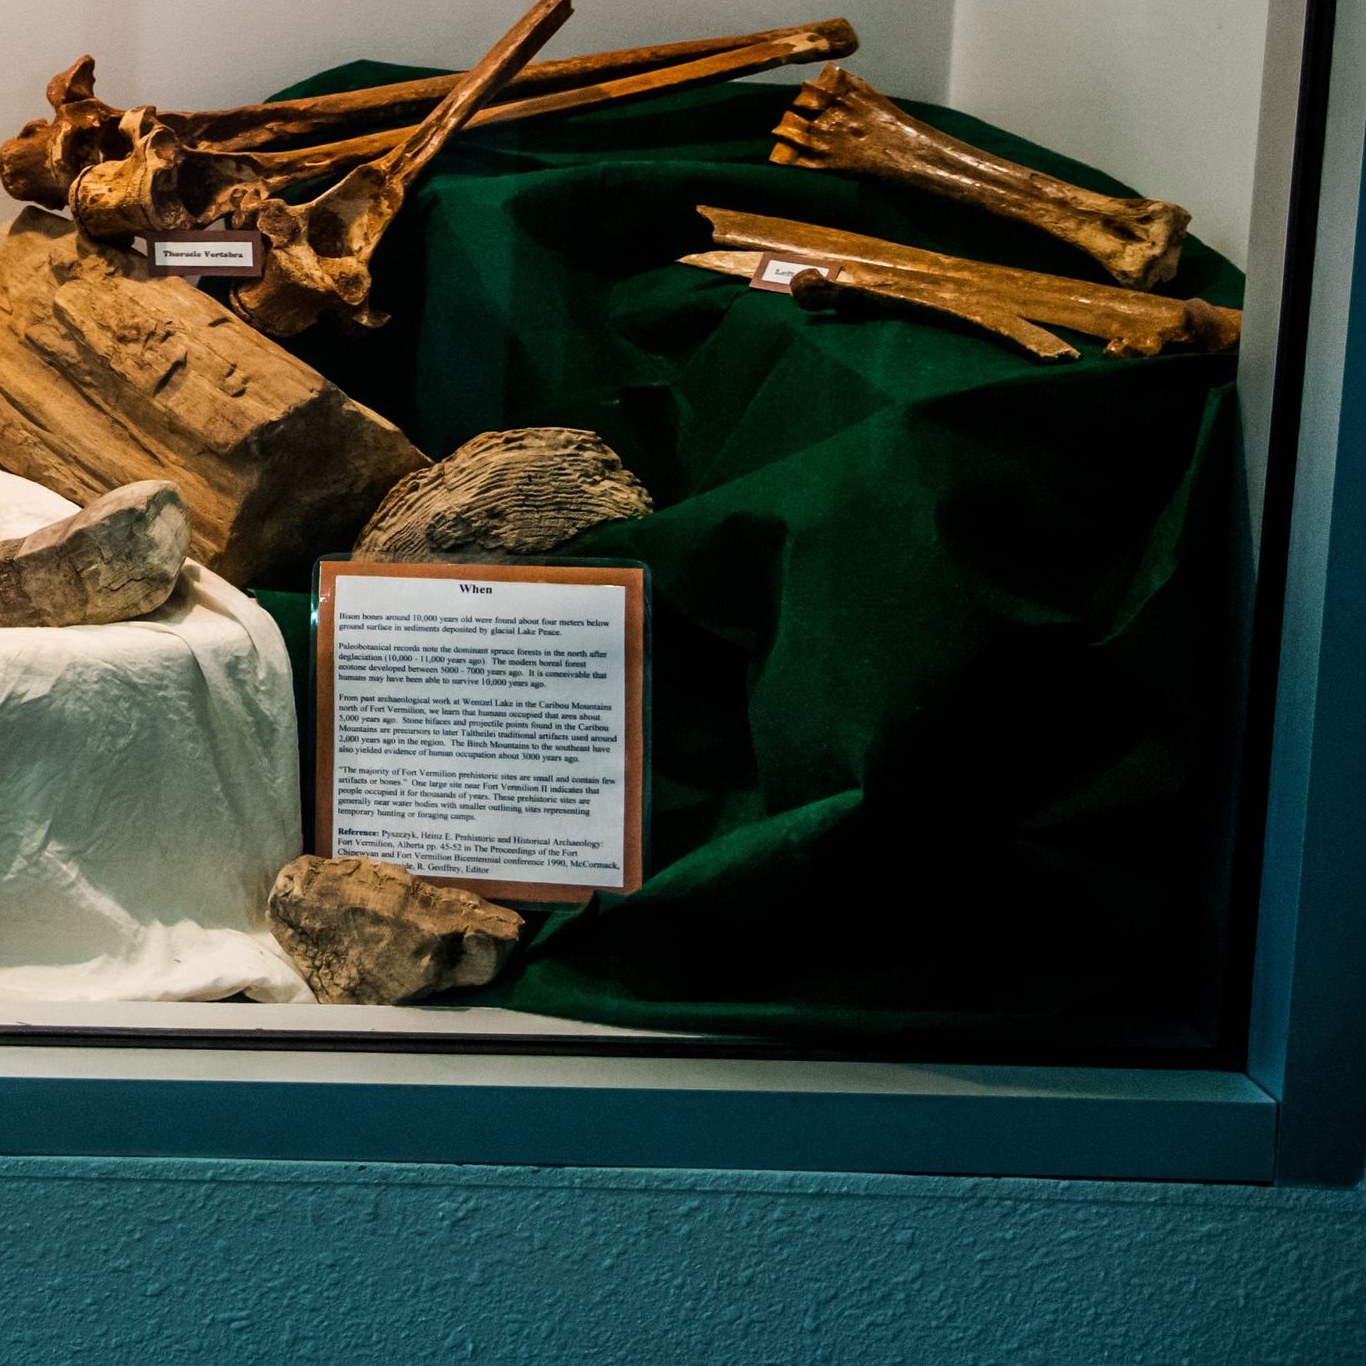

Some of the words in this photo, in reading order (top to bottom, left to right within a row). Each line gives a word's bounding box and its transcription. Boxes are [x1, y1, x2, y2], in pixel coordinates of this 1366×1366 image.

[459, 583, 492, 594] When
[339, 612, 360, 620] Bison
[361, 612, 383, 620] bones
[413, 614, 437, 622] 10,000
[438, 616, 458, 624] years
[494, 616, 516, 624] found
[541, 617, 557, 625] four
[586, 618, 609, 626] below
